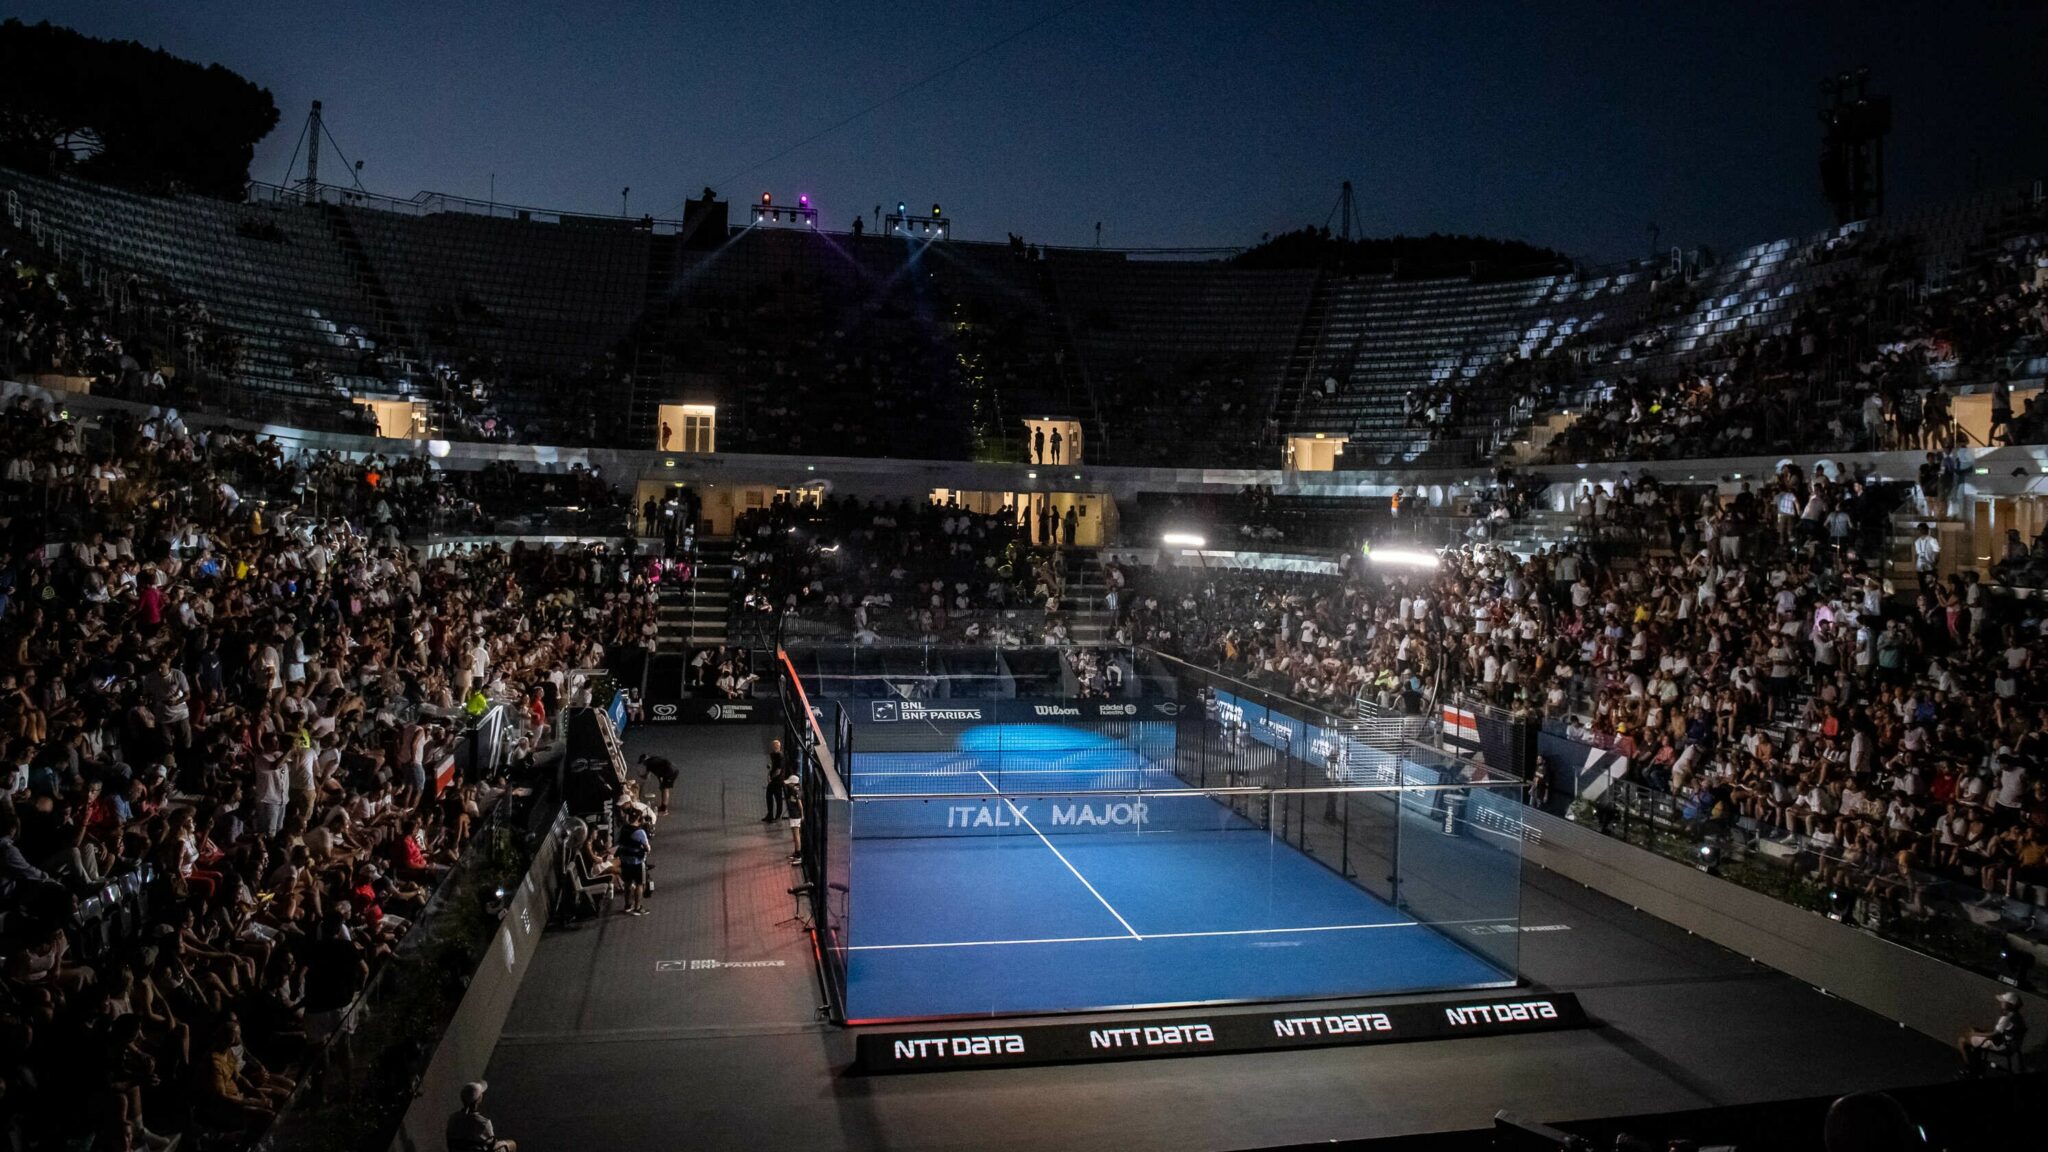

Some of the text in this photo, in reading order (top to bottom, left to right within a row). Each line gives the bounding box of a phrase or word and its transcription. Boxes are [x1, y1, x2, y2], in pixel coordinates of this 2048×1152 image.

[901, 701, 926, 709] BNL
[1034, 705, 1080, 716] Wilson
[902, 711, 982, 720] BNP PARIBAS
[948, 803, 1149, 828] ITALY MAJOR
[1446, 1006, 1491, 1025] NTT
[1273, 1017, 1322, 1037] NTT
[1090, 1028, 1141, 1048] NTT
[894, 1038, 948, 1059] NTT
